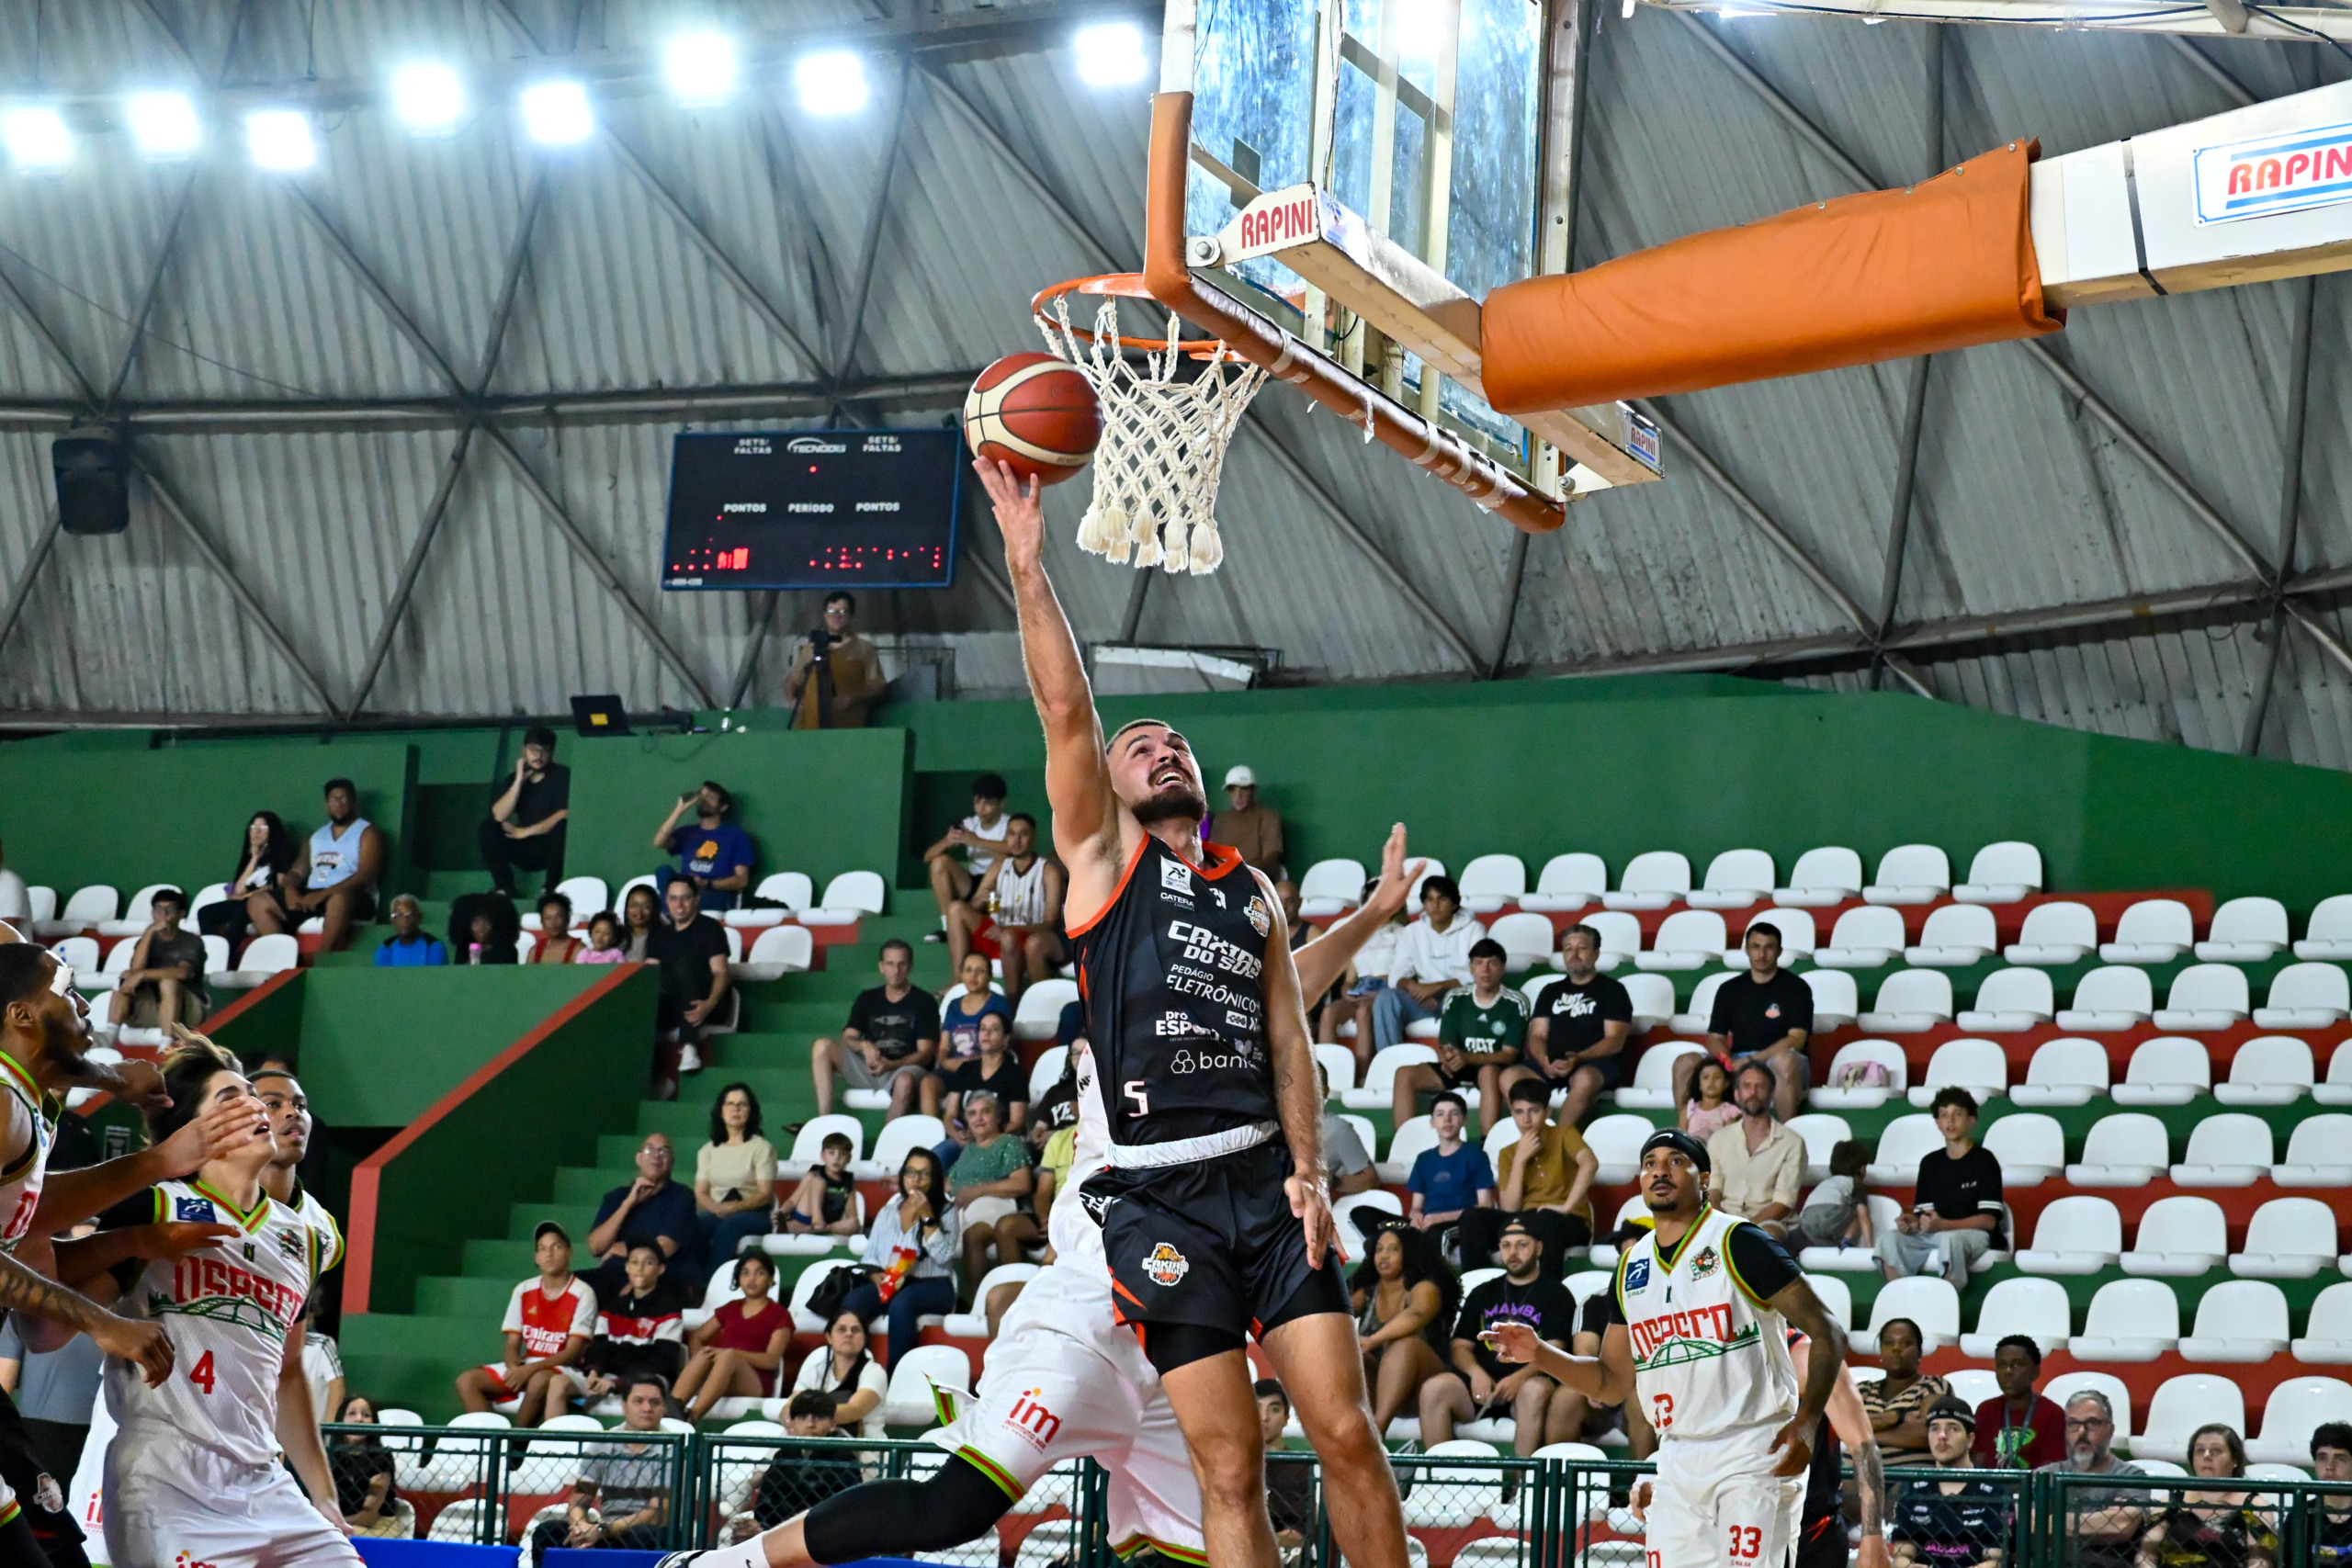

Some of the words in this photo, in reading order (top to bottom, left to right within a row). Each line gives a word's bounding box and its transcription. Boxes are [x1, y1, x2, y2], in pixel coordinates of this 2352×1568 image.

[1241, 198, 1313, 249] RAPINI
[739, 438, 769, 447] SETS/
[863, 445, 901, 453] FALTAS
[867, 435, 899, 445] SETS/
[1631, 427, 1656, 457] RAPINI
[734, 446, 772, 455] FALTAS
[724, 503, 767, 513] PONTOS
[787, 502, 834, 513] PERÍODO
[855, 502, 900, 512] PONTOS
[1167, 919, 1262, 977] CAXIAS
[1183, 944, 1215, 964] DO
[1170, 964, 1215, 982] PEDÁGIO
[1166, 975, 1256, 1013] ELETRÔNICO
[1124, 1080, 1148, 1118] 5
[1484, 1302, 1543, 1326] MAMBA
[189, 1349, 216, 1395] 4
[1729, 1525, 1762, 1559] 33
